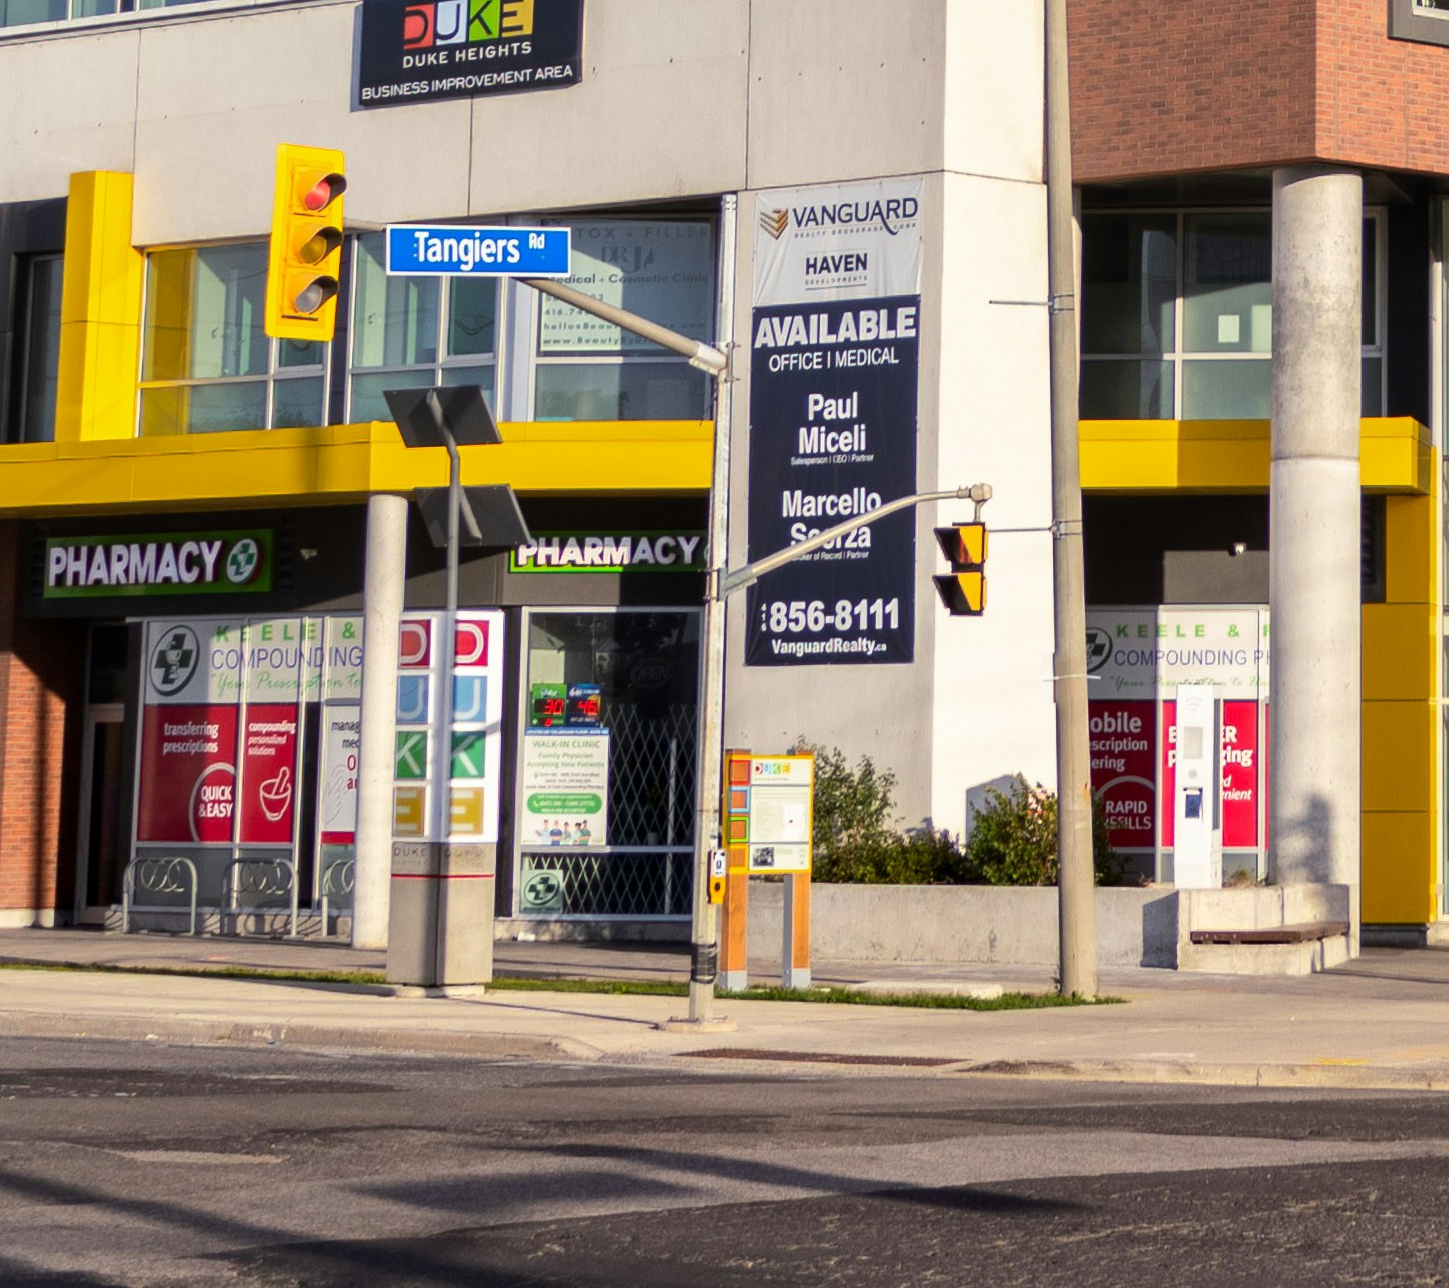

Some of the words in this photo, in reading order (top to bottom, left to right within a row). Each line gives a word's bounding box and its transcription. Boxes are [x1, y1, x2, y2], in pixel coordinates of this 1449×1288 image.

[403, 51, 449, 69] DUKE
[455, 42, 532, 63] HEIGHTS
[362, 81, 429, 100] BUSINESS
[431, 69, 533, 93] IMPROVEMENT
[535, 64, 573, 81] AREA
[793, 197, 918, 234] VANGUARD
[794, 230, 827, 239] REALTY
[831, 226, 884, 236] BROKERAGE
[414, 231, 520, 271] Tangiers
[528, 232, 545, 249] Rd
[805, 253, 868, 275] HAVEN
[805, 276, 868, 286] DEVELOPMENTS
[754, 307, 917, 349] AVAILABLE
[769, 352, 822, 372] OFFICE
[835, 347, 899, 368] MEDICAL
[808, 391, 858, 421] Paul
[799, 424, 866, 454] Miceli
[782, 487, 882, 518] Marcello
[518, 536, 700, 565] PHARMACY
[49, 540, 223, 587] PHARMACY
[770, 598, 898, 632] 856-8111
[216, 623, 316, 642] KEELE
[342, 623, 356, 640] &
[1116, 624, 1205, 638] KEELE
[1227, 624, 1239, 638] &
[211, 646, 364, 670] COMPOUNDING
[771, 637, 887, 657] VanguardRealty.ca
[1114, 649, 1247, 666] COMPOUNDING
[164, 721, 219, 739] transferring
[248, 720, 296, 735] compounding
[331, 721, 360, 733] manag
[450, 623, 485, 832] DUKE
[1090, 711, 1142, 733] obile
[163, 739, 218, 756] prescriptions
[248, 735, 288, 746] personalized
[248, 747, 276, 756] solutions
[1091, 756, 1125, 771] ering
[201, 786, 232, 801] QUICK
[1106, 801, 1148, 814] RAPID
